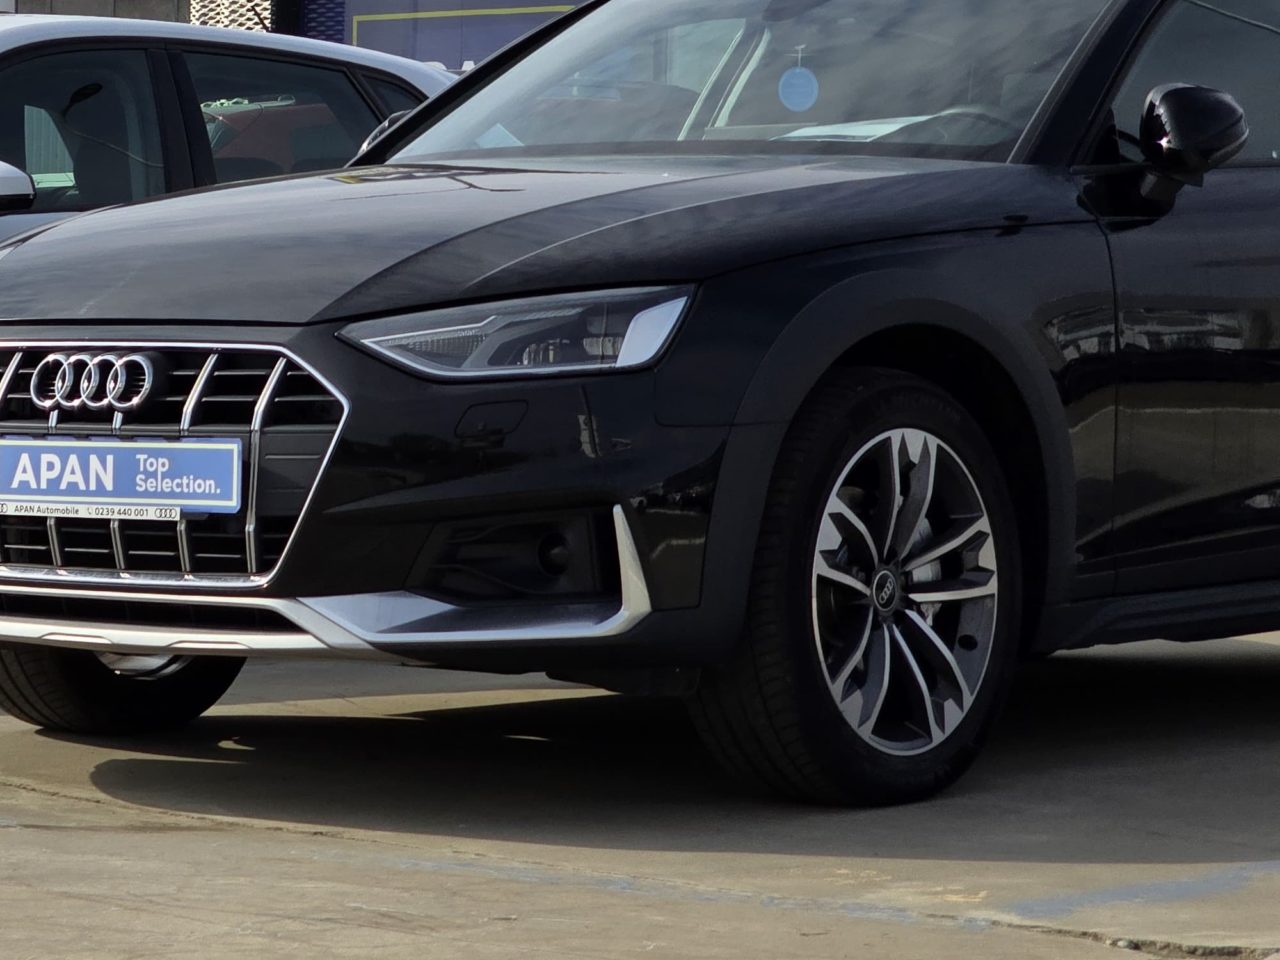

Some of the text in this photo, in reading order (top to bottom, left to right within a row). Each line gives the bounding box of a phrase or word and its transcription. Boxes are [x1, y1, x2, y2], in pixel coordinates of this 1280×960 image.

[11, 453, 114, 491] APAN
[136, 454, 169, 474] Top
[136, 475, 220, 495] Selection.
[14, 505, 149, 518] APAN Automobile 0239 440 001
